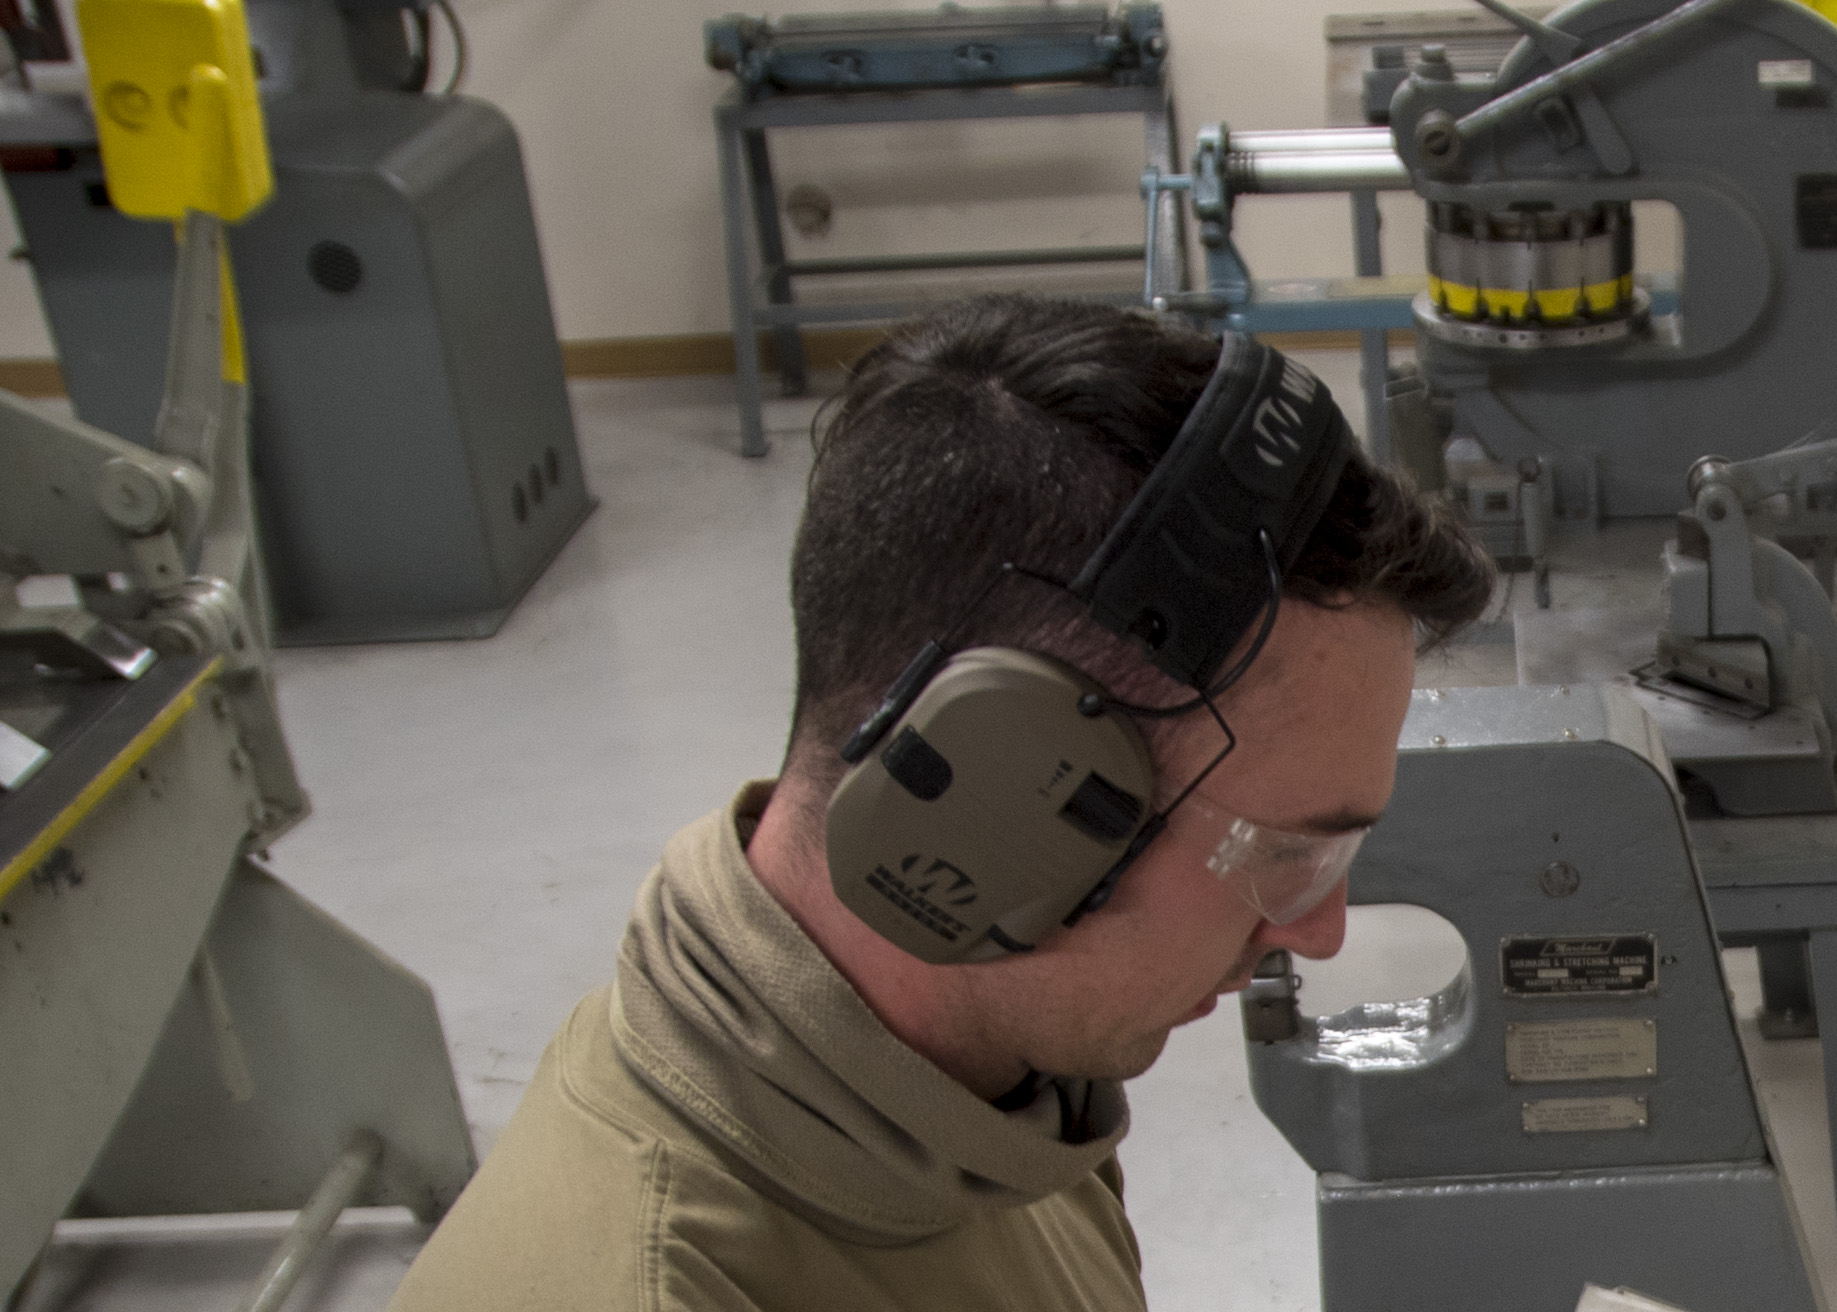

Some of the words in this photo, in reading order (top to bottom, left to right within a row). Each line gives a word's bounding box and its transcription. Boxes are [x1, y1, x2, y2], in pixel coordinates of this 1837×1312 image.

[1509, 958, 1552, 968] SHRINKING
[1554, 957, 1560, 967] &
[1563, 956, 1610, 967] STRETCHING
[1612, 954, 1648, 965] MACHINE
